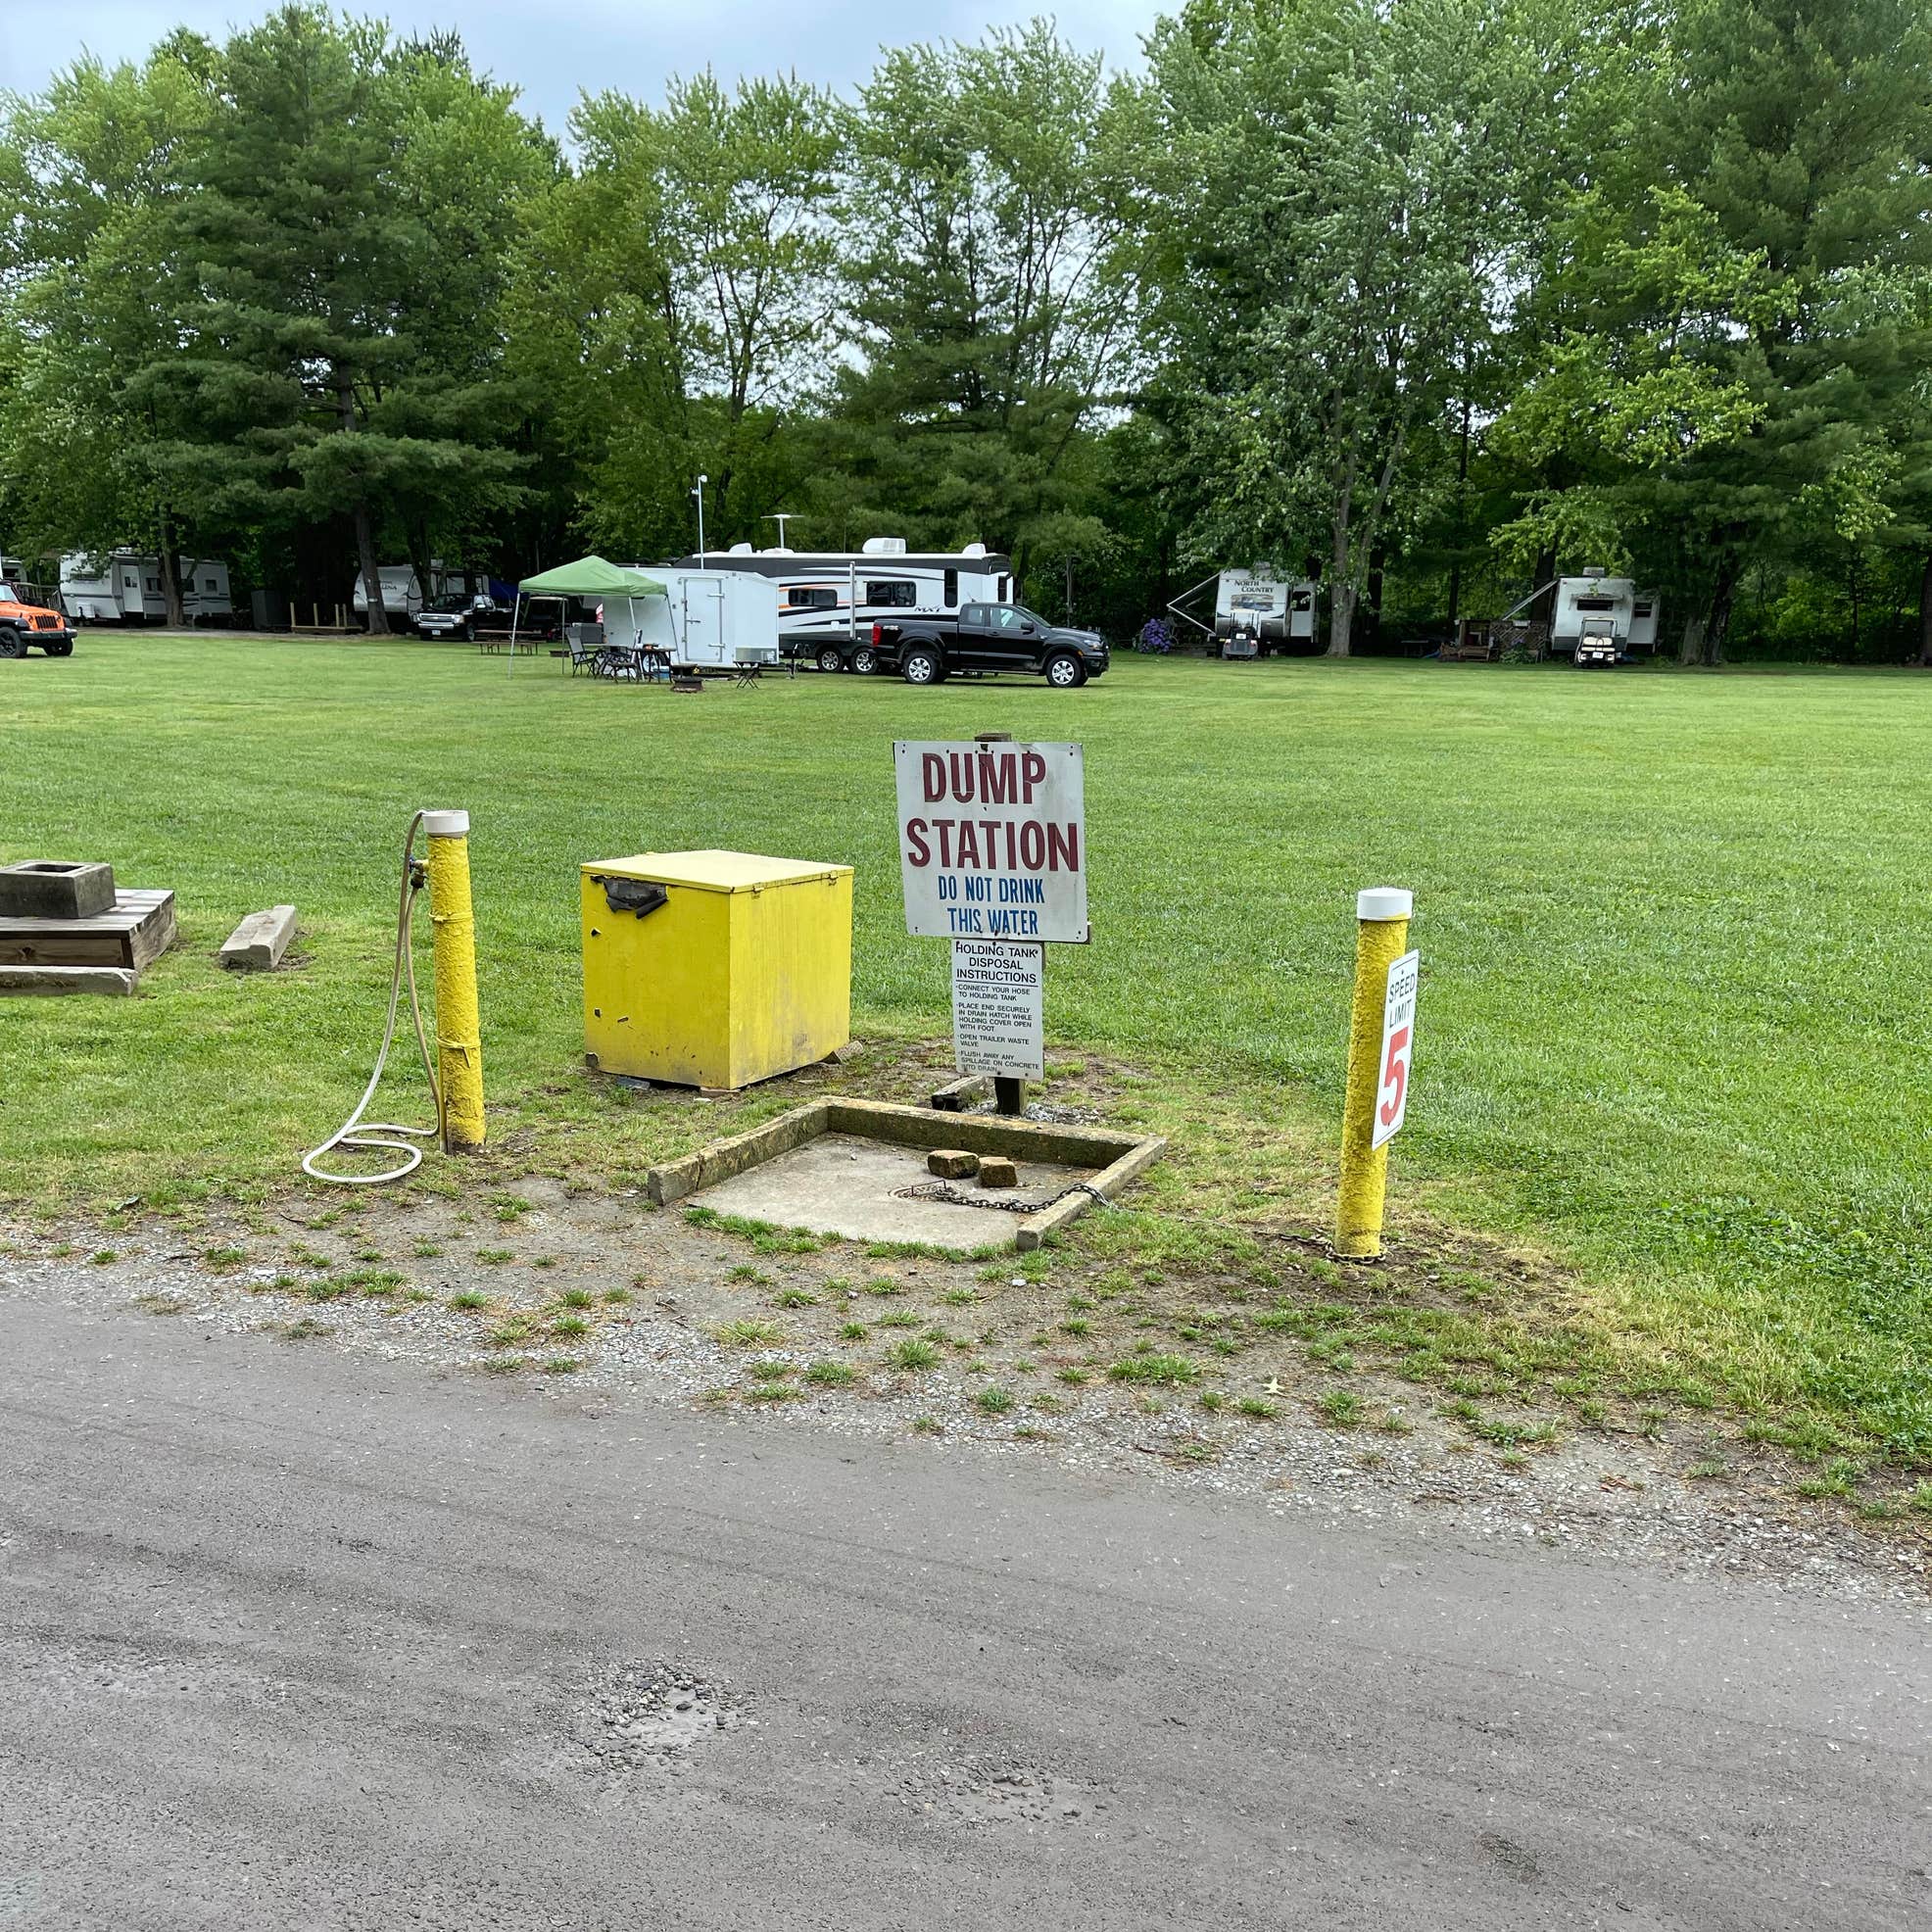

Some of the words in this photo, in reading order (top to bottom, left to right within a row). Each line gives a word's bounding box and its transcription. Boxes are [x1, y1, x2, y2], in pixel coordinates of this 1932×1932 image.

[922, 752, 1046, 804] DUMP
[906, 818, 1079, 872] STATION
[938, 875, 957, 900] DO
[965, 876, 992, 902] NOT
[998, 878, 1045, 903] DRINK
[947, 907, 982, 933] THIS
[988, 909, 1038, 935] WATER
[956, 943, 1004, 956] HOLDING
[1008, 947, 1037, 958] TANK
[969, 957, 1024, 970] DISPOSAL
[956, 968, 1037, 984] INSTRUCTIONS
[958, 984, 990, 992] CONNECT
[1388, 973, 1416, 1003] SPEED
[997, 1005, 1031, 1014] SECURELY
[1389, 998, 1413, 1029] LIMIT
[1004, 1061, 1039, 1070] CONCRETE
[1380, 1026, 1409, 1126] 5
